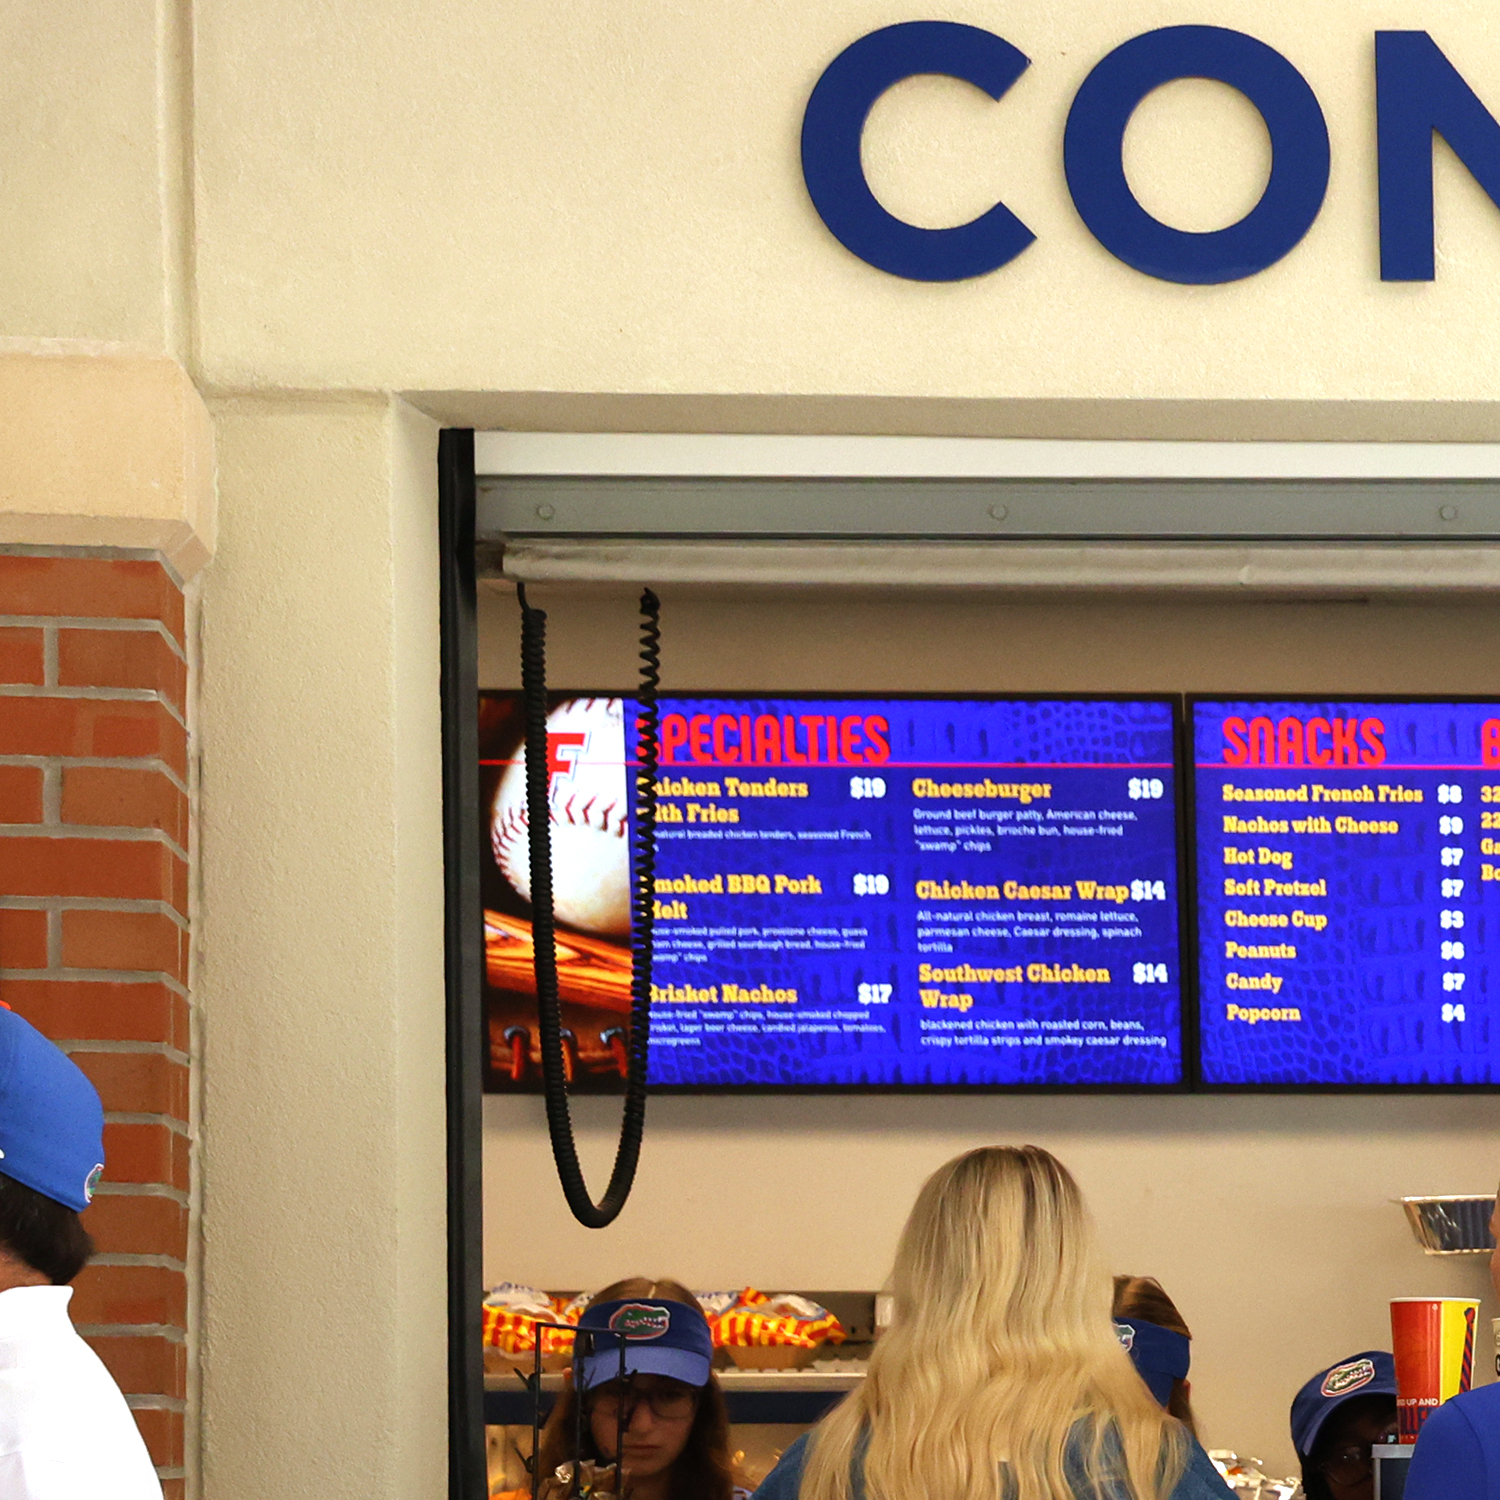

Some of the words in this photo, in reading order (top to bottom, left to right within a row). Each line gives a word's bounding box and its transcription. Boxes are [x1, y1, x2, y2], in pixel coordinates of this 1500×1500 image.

[1222, 716, 1386, 765] SNACKS
[724, 777, 808, 797] Tenders
[850, 776, 886, 800] $19
[912, 778, 1052, 804] Cheeseburger
[1128, 777, 1164, 800] $19
[1222, 784, 1309, 802] Seasoned
[1311, 784, 1375, 802] French
[1378, 785, 1423, 802] Fries
[1437, 784, 1463, 804] $8
[635, 803, 683, 823] ith
[686, 803, 740, 823] Fries
[913, 808, 952, 820] Ground
[953, 809, 976, 820] beef
[978, 809, 1014, 822] burger
[1016, 810, 1044, 822] patty,
[1046, 808, 1096, 820] American
[1098, 809, 1138, 821] cheese,
[1223, 815, 1289, 833] Nachos
[1291, 816, 1332, 833] with
[1335, 816, 1398, 834] Cheese
[1439, 815, 1464, 836] $9
[1224, 847, 1255, 864] Hot
[1258, 847, 1293, 870] Dog
[1440, 846, 1464, 867] $7
[640, 874, 723, 894] moked
[727, 874, 771, 894] BBQ
[774, 874, 822, 894] Pork
[853, 873, 889, 896] $19
[916, 880, 1000, 900] Chicken
[1004, 880, 1072, 900] Caesar
[1076, 880, 1128, 904] Wrap
[1130, 879, 1166, 902] $14
[1224, 878, 1260, 896] Soft
[1263, 878, 1327, 896] Pretzel
[1441, 878, 1464, 898] $7
[916, 910, 974, 922] All-natural
[975, 911, 1015, 922] chicken
[1017, 910, 1053, 922] breast,
[1055, 912, 1098, 922] romaine
[1100, 910, 1139, 922] lettuce,
[1224, 910, 1289, 927] Cheese
[1292, 910, 1327, 931] Cup
[1440, 909, 1464, 930] $3
[917, 942, 953, 953] tortilla
[1225, 941, 1296, 958] Peanuts
[1440, 940, 1465, 961] $6
[919, 963, 1023, 983] Southwest
[1027, 963, 1111, 983] Chicken
[1132, 962, 1168, 984] $14
[1226, 972, 1283, 994] Candy
[1442, 971, 1466, 992] $7
[721, 984, 798, 1003] Nachos
[858, 982, 892, 1006] $17
[919, 989, 973, 1012] Wrap
[1227, 1004, 1301, 1024] Popcorn
[1441, 1002, 1466, 1023] $4
[920, 1019, 973, 1030] blackened
[974, 1019, 1015, 1030] chicken
[1016, 1018, 1039, 1030] with
[1040, 1019, 1080, 1030] roasted
[1081, 1021, 1108, 1030] corn,
[1110, 1019, 1144, 1031] beans,
[920, 1036, 952, 1048] crispy
[954, 1035, 990, 1046] tortilla
[991, 1036, 1022, 1048] strips
[1023, 1034, 1042, 1046] and
[1044, 1035, 1084, 1047] smokey
[1085, 1036, 1120, 1046] caesar
[1122, 1034, 1167, 1048] dressing
[1419, 1398, 1439, 1406] AND
